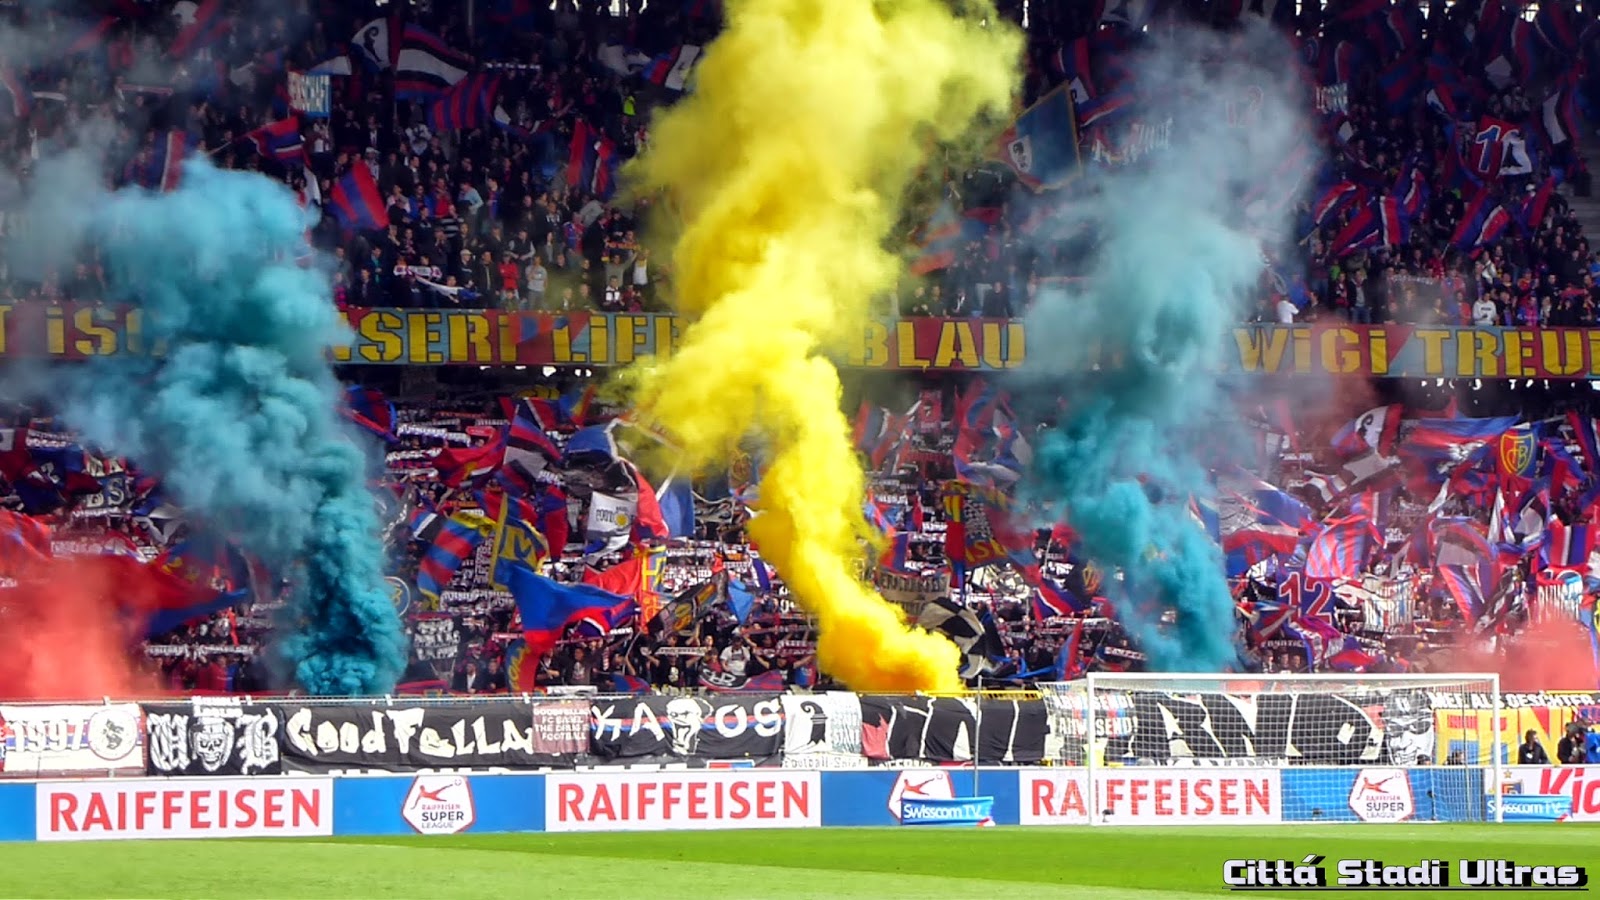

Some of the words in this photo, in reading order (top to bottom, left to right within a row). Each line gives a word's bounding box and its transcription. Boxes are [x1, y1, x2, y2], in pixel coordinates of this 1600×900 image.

[1230, 327, 1389, 376] WiGi
[1279, 572, 1332, 626] 12
[7, 720, 86, 752] 1997
[534, 724, 554, 732] THE
[50, 789, 320, 832] RAIFFEISEN
[558, 780, 809, 822] RAIFFEISEN
[903, 803, 962, 819] Swisscom
[963, 804, 983, 818] TV
[1366, 802, 1405, 812] SUPER
[1487, 800, 1543, 814] Sisscom
[421, 811, 464, 822] SUPER
